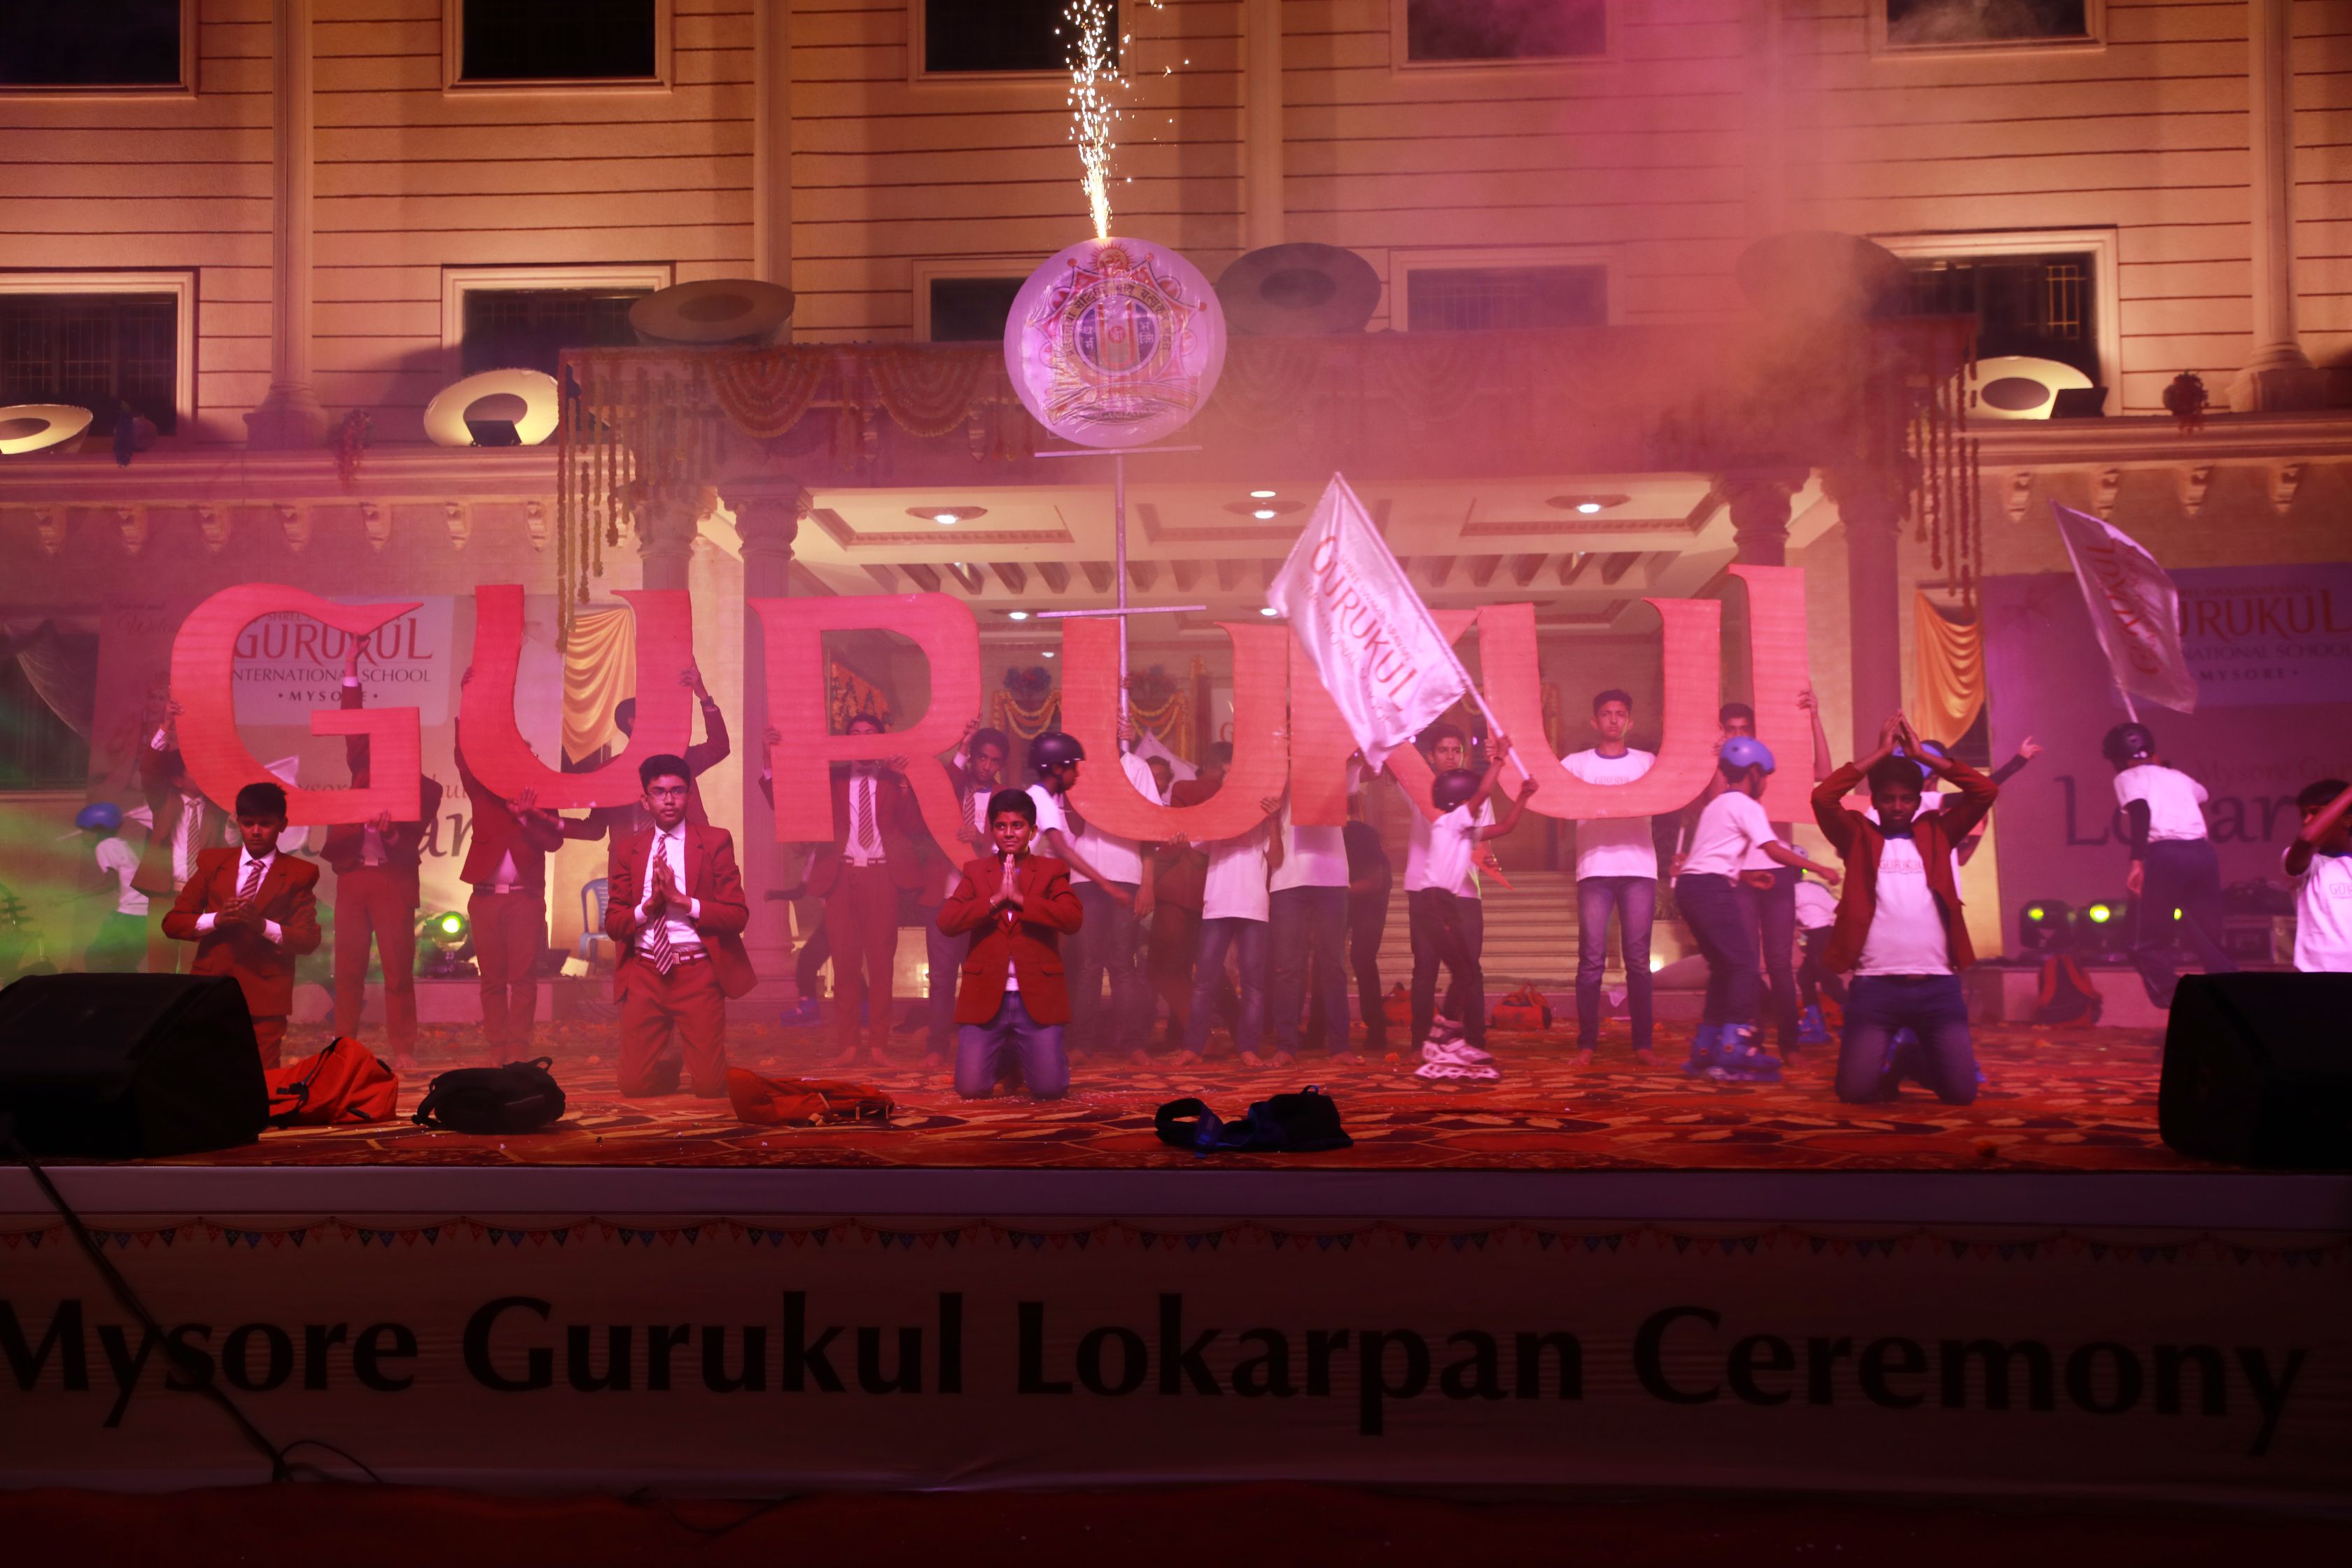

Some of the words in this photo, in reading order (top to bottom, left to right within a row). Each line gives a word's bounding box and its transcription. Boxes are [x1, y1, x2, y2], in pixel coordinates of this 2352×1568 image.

[361, 668, 431, 682] SCHOOL
[0, 1295, 419, 1428] Mysore
[462, 1291, 963, 1396] Gurukul
[1016, 1292, 1584, 1438] Lokarpan
[1632, 1304, 2309, 1457] Ceremony
